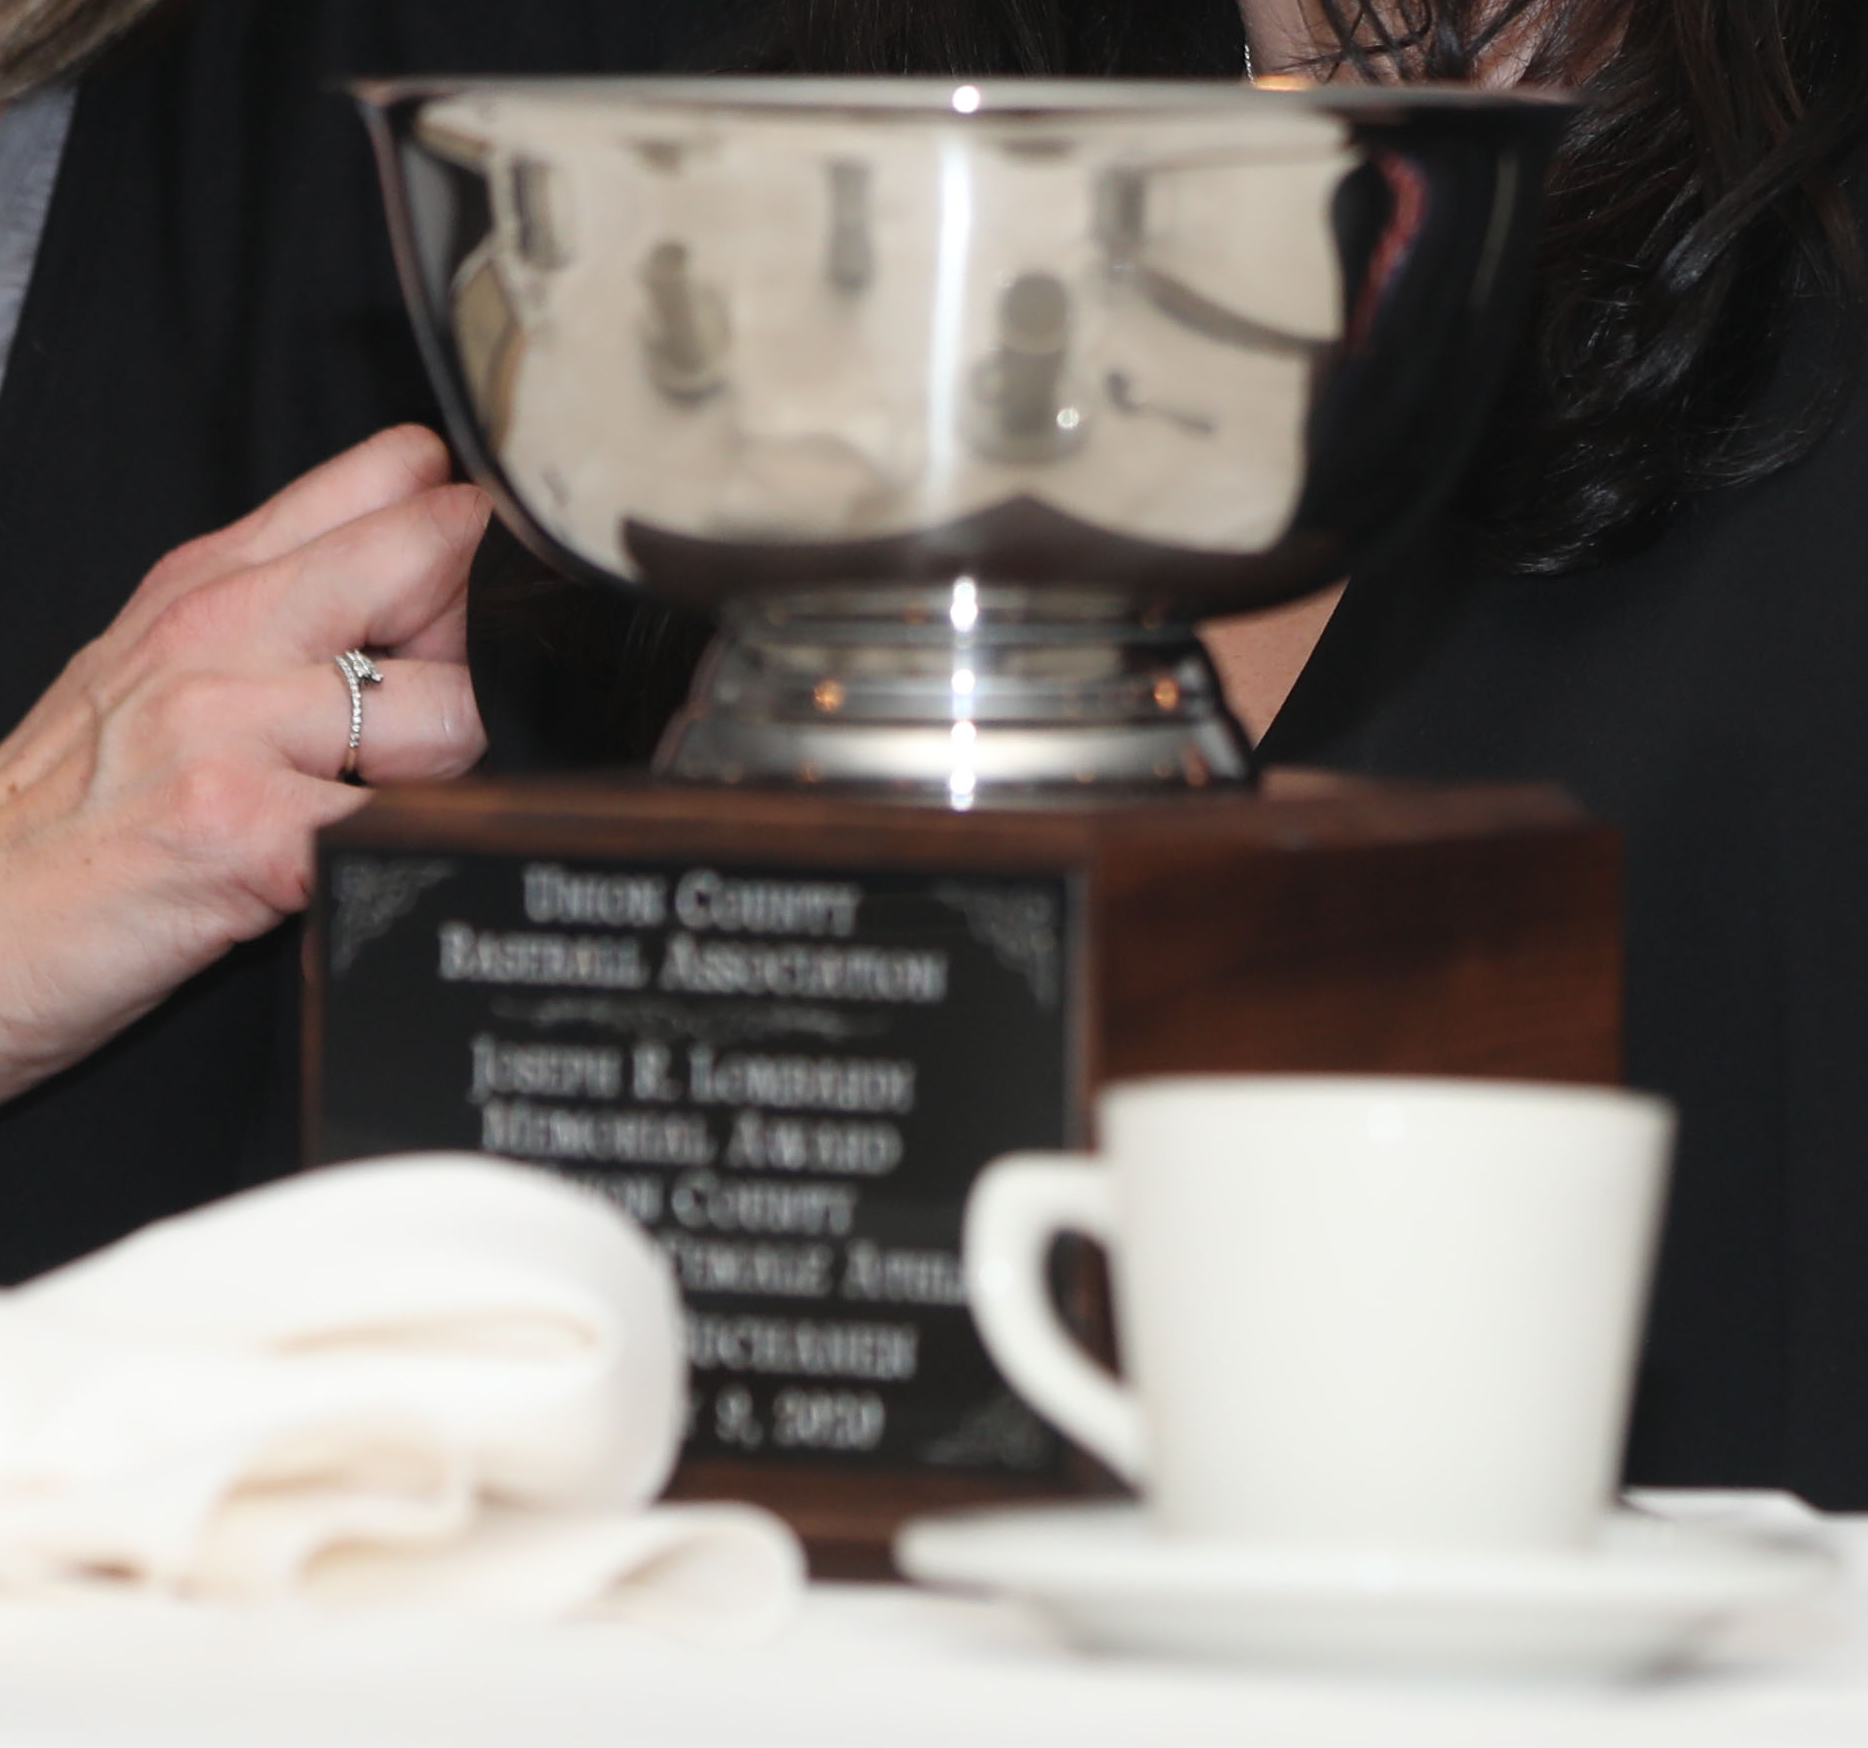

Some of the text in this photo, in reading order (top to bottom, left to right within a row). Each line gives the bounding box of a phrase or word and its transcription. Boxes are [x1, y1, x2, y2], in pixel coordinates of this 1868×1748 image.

[524, 864, 860, 937] UNION COUNTY
[438, 920, 947, 1002] BASEBALL ASSOCIATION
[467, 1034, 623, 1103] JOSEPH
[483, 1097, 904, 1176] MEMORIAL AWARD
[671, 1168, 859, 1236] COUNTY
[840, 1238, 969, 1306] ATHL
[772, 1386, 885, 1451] 2020
